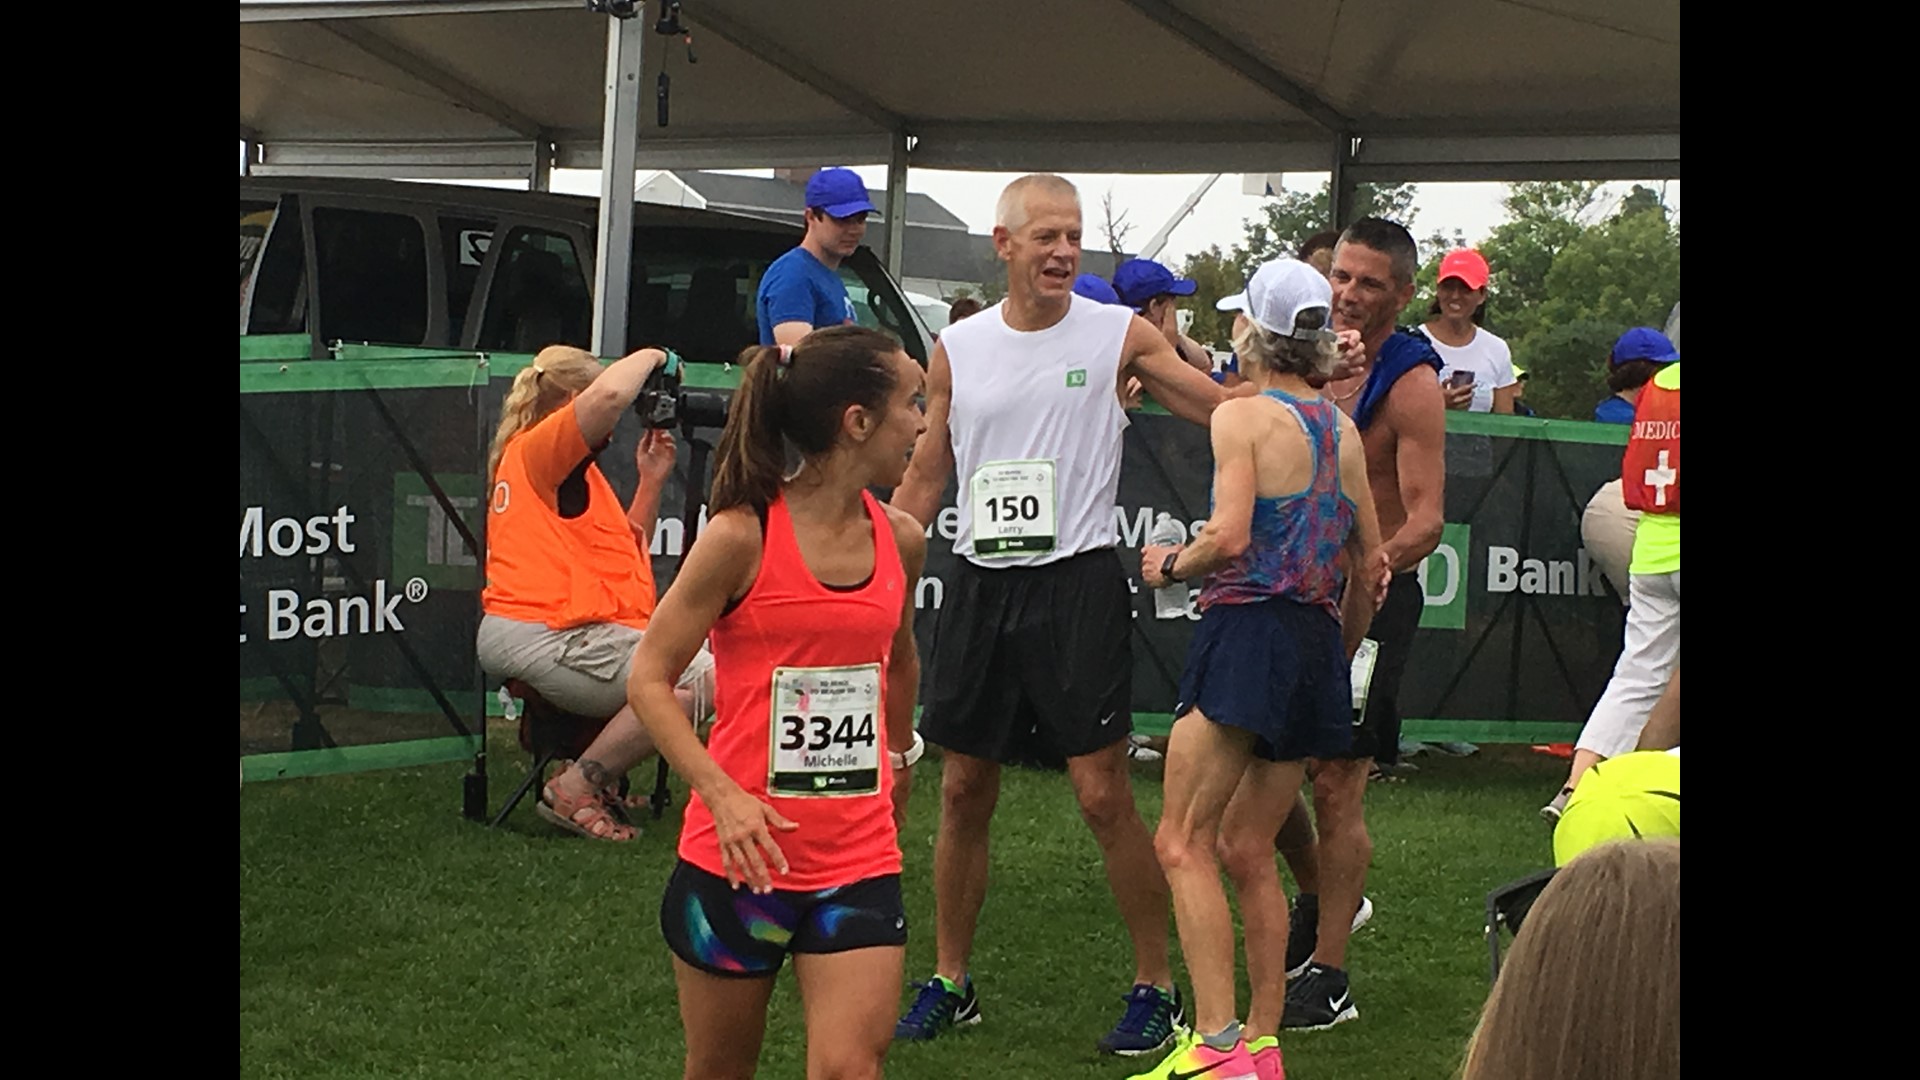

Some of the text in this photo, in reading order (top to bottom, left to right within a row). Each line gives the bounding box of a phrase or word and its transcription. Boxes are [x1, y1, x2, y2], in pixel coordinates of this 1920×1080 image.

[1632, 420, 1680, 440] MEDIC
[985, 495, 1039, 522] 150
[998, 526, 1024, 534] Larry
[1487, 546, 1607, 596] Bank
[780, 713, 875, 751] 3344
[804, 754, 858, 767] Michelle
